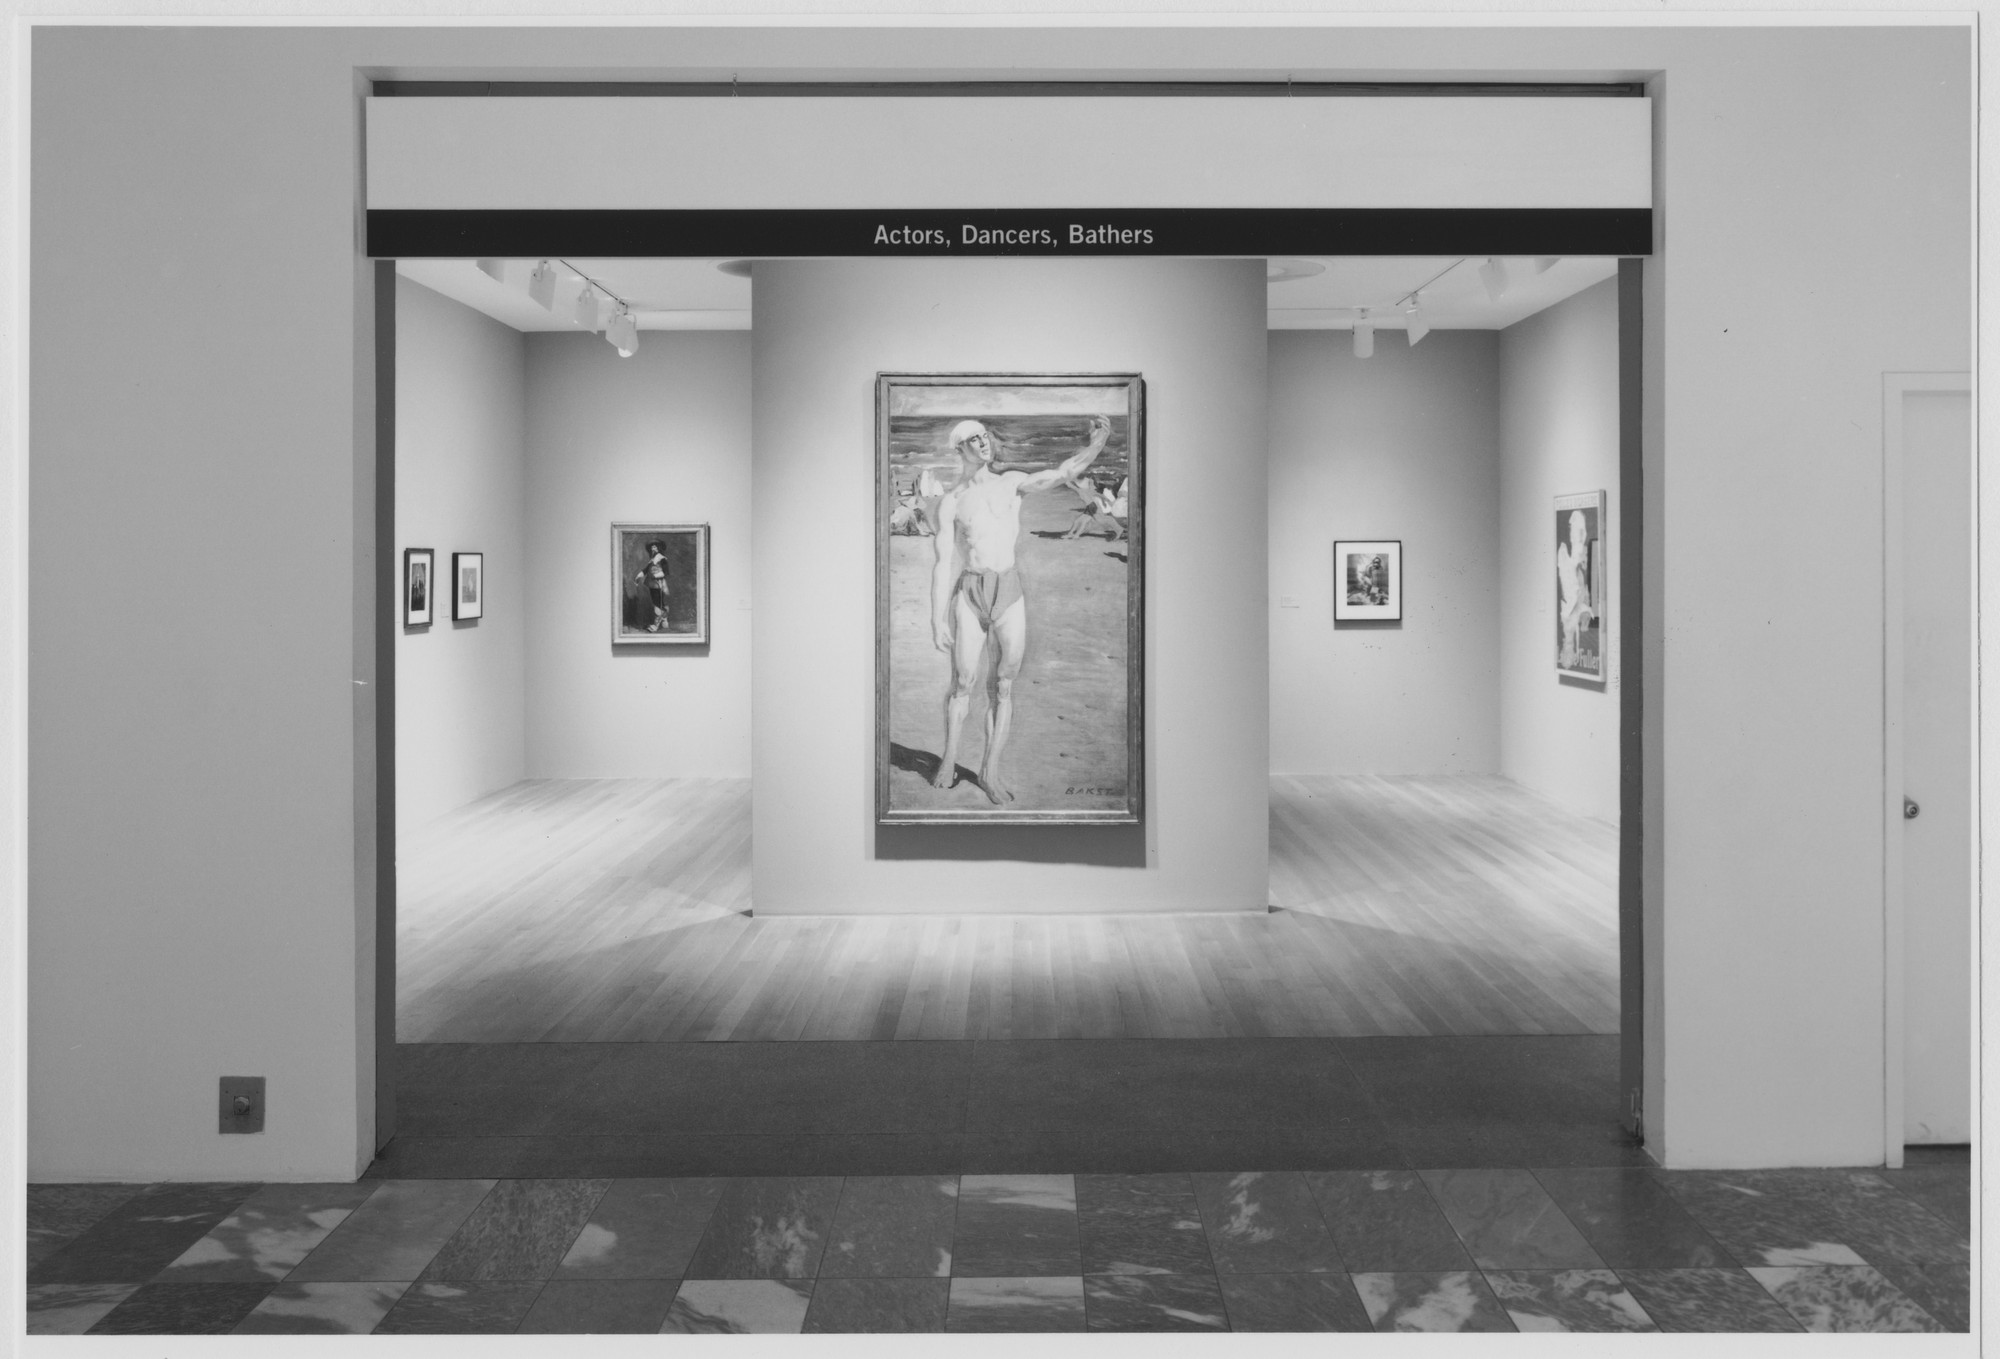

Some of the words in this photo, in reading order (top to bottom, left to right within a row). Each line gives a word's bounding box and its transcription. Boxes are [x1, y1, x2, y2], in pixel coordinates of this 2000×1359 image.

[873, 224, 951, 248] Actors,
[962, 224, 1058, 248] Dancers,
[1069, 224, 1154, 244] Bathers
[1064, 786, 1113, 797] BAKST
